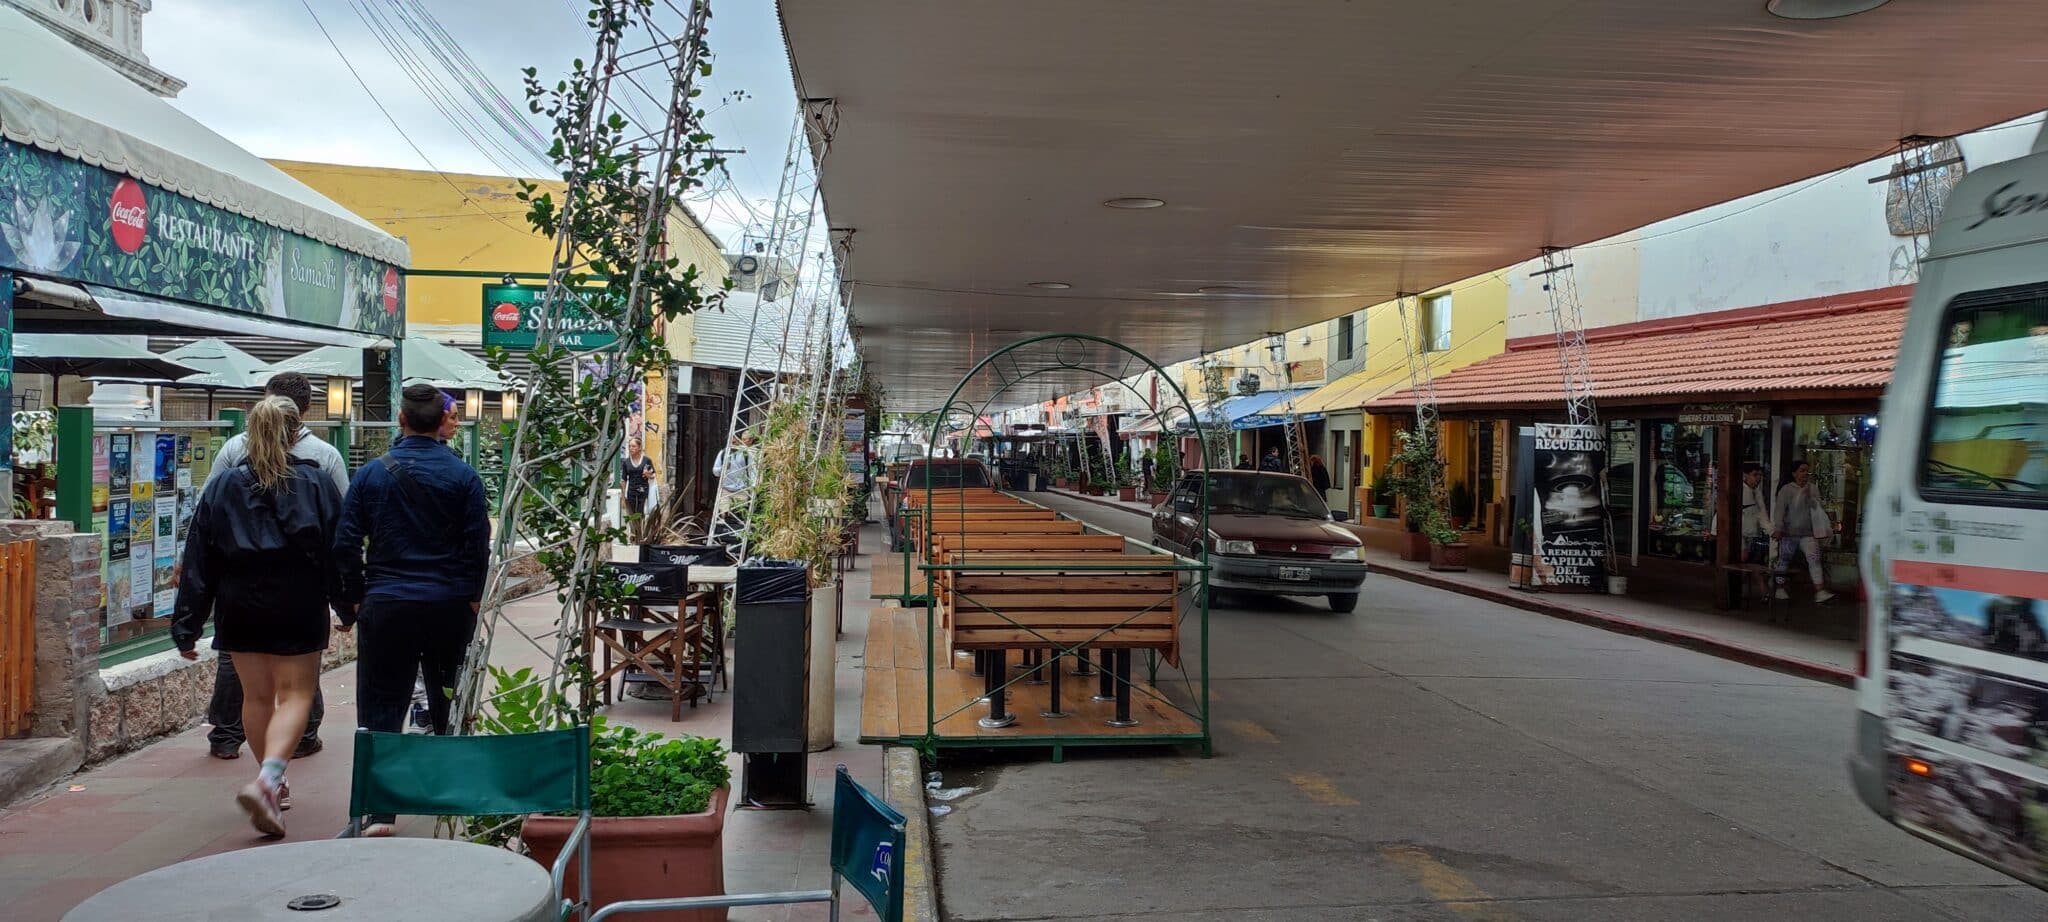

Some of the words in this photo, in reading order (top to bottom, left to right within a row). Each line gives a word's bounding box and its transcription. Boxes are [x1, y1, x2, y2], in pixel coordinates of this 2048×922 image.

[158, 212, 255, 262] RESTAURANTE
[290, 247, 337, 291] Samadhi
[559, 335, 583, 345] BAR
[1560, 427, 1604, 440] MEJOR
[1535, 438, 1606, 452] RECUERDO!
[1534, 548, 1546, 556] LA
[1548, 549, 1588, 557] REMERA
[1541, 557, 1596, 567] CAPILLA
[1556, 566, 1581, 575] DEL
[618, 573, 656, 589] Miller
[1546, 575, 1591, 584] MONTE
